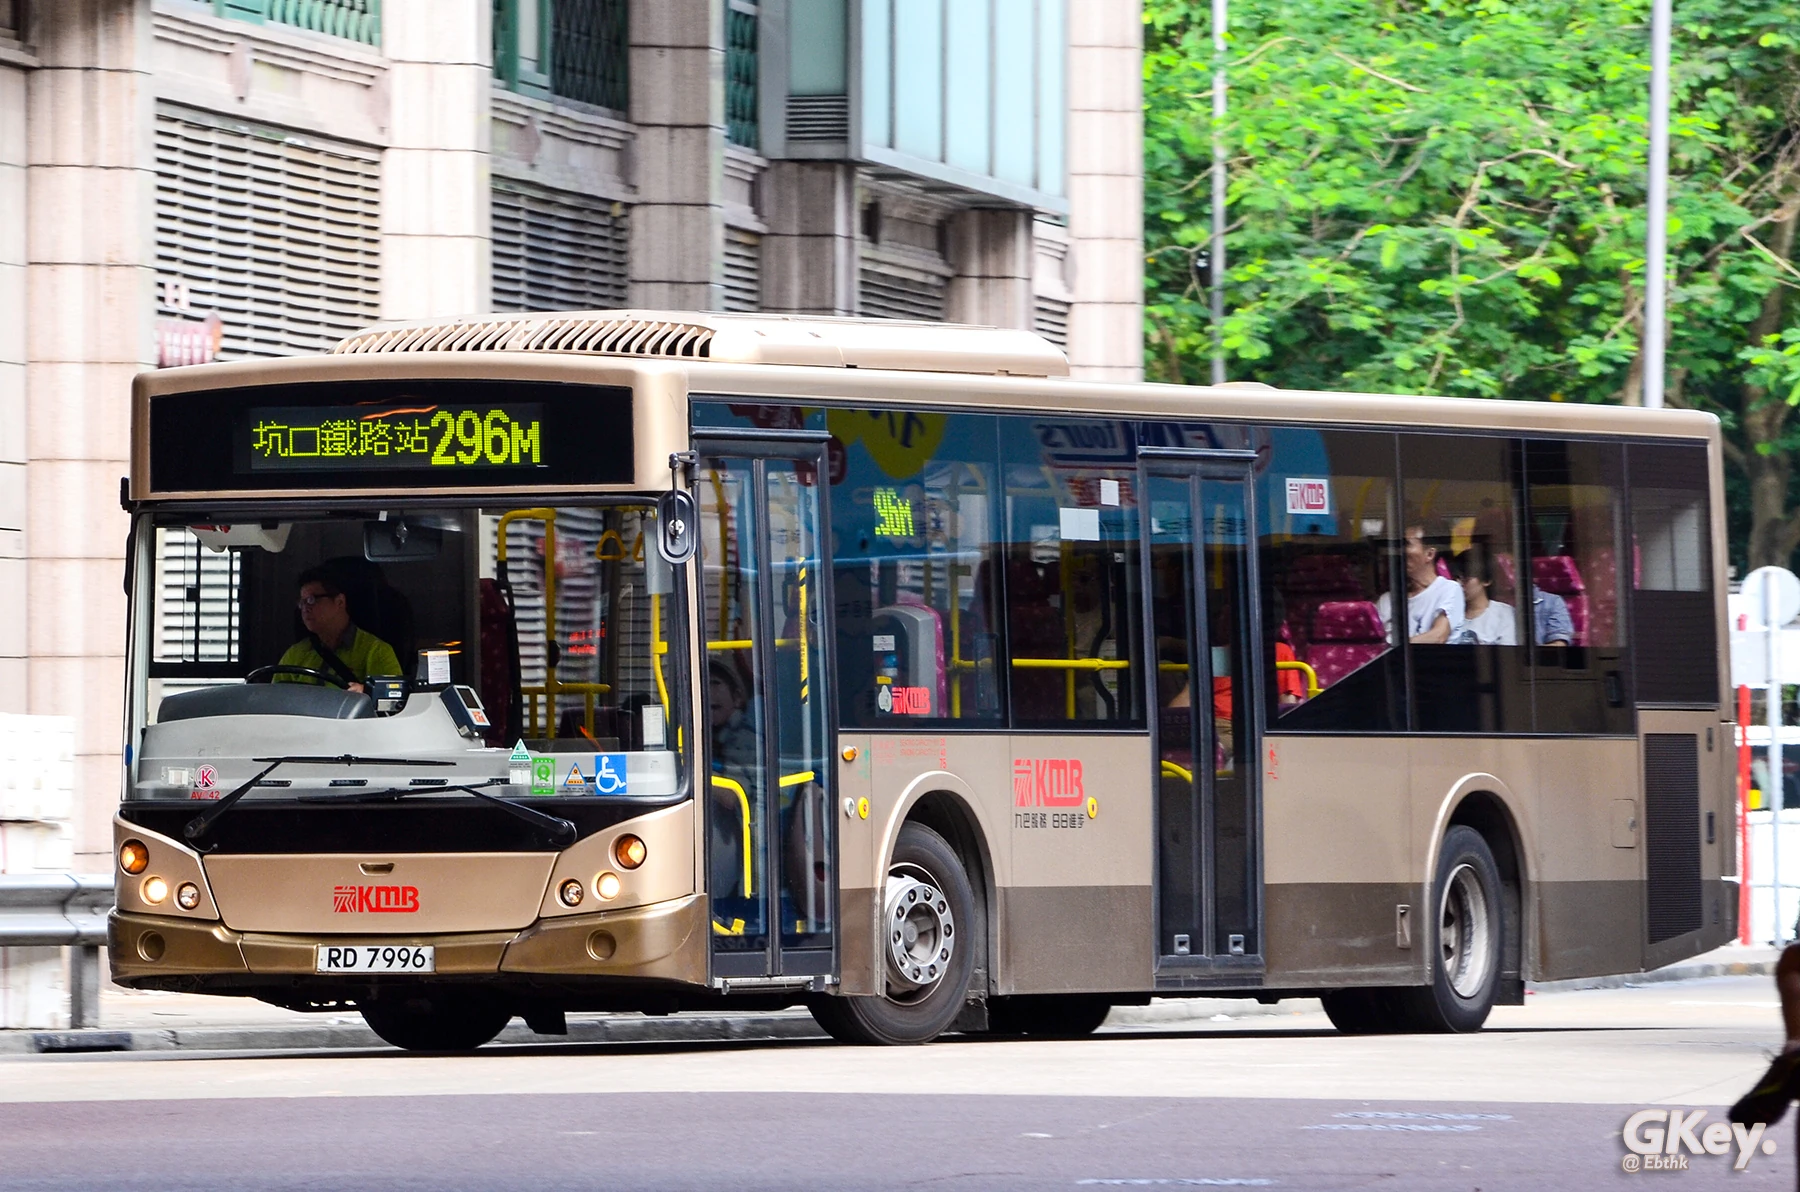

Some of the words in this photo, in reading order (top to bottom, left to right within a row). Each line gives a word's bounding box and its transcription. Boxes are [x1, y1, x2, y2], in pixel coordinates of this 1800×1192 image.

[253, 419, 430, 457] 坑口鐵路站
[431, 409, 541, 466] 296M
[903, 687, 931, 715] KMB
[1035, 758, 1085, 807] KMB
[358, 885, 420, 913] KMB
[327, 947, 358, 968] RD
[367, 947, 426, 969] 7996
